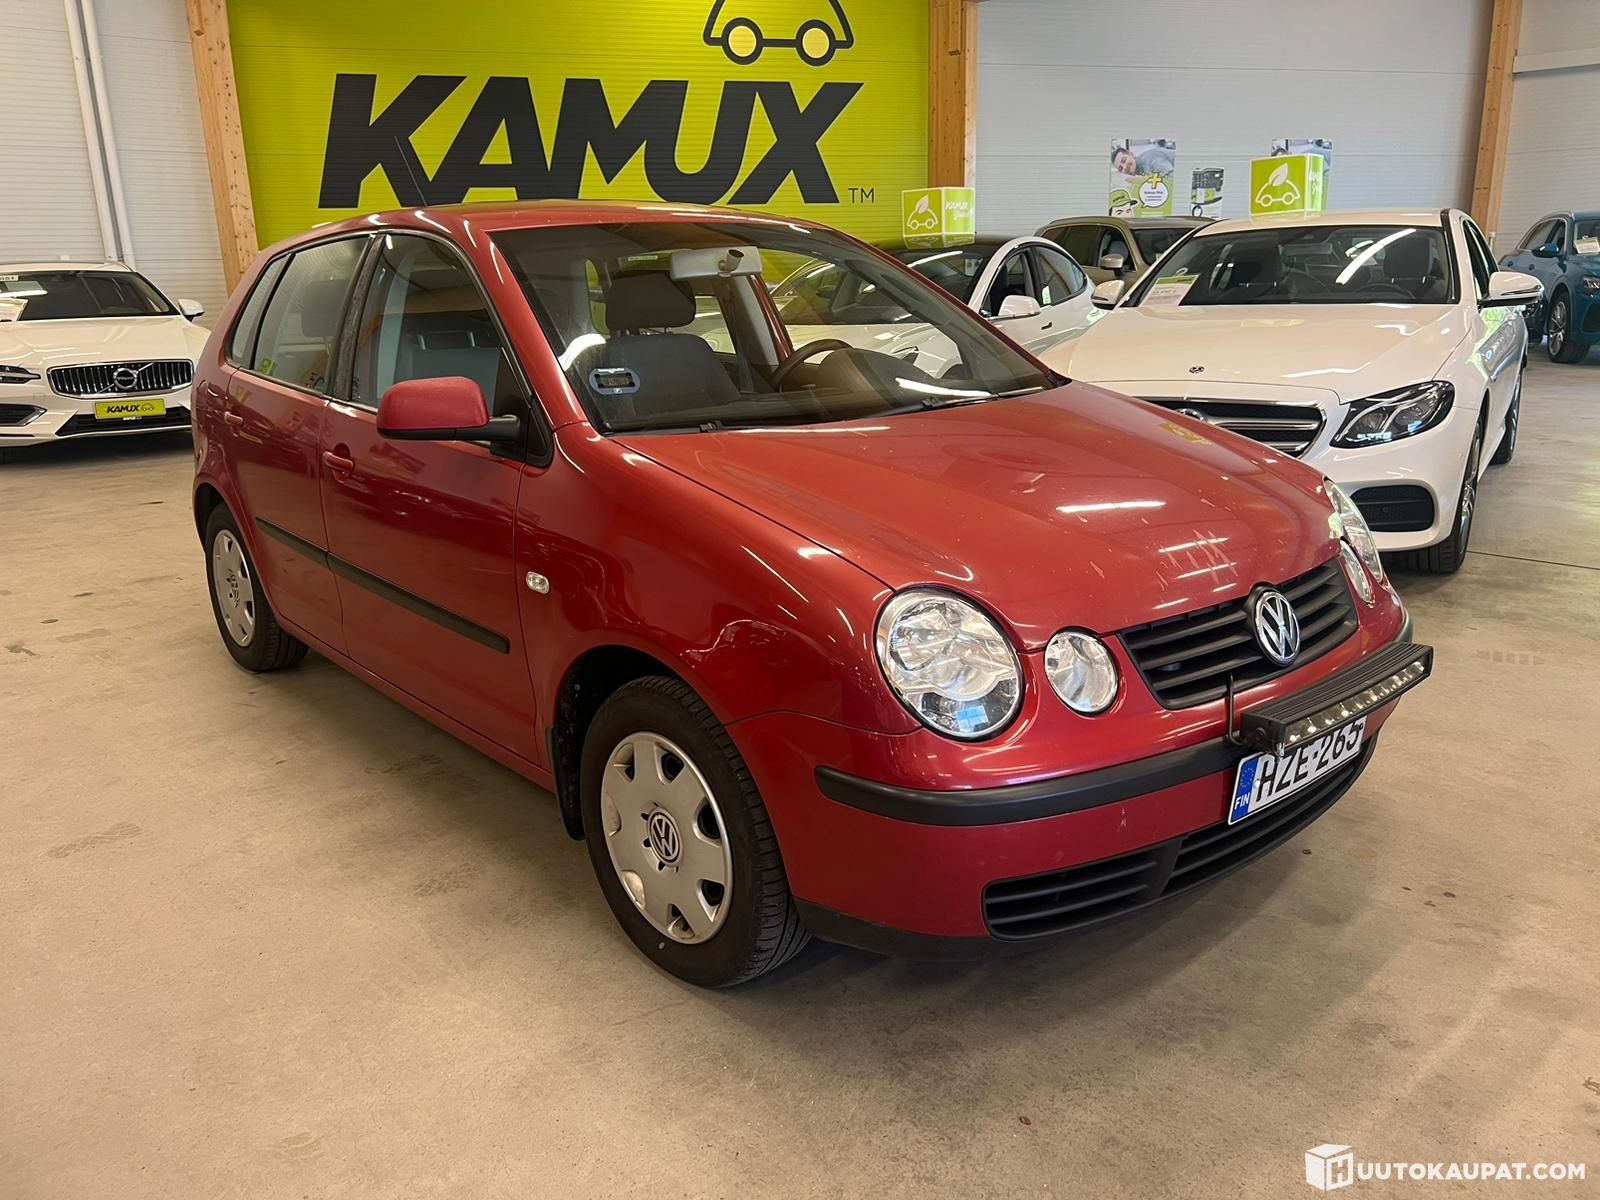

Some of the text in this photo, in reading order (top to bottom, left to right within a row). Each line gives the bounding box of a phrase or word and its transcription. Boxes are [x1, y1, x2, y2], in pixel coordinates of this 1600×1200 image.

[318, 73, 864, 208] KAMUX
[106, 404, 141, 414] KAMUX
[1234, 792, 1251, 810] FIN
